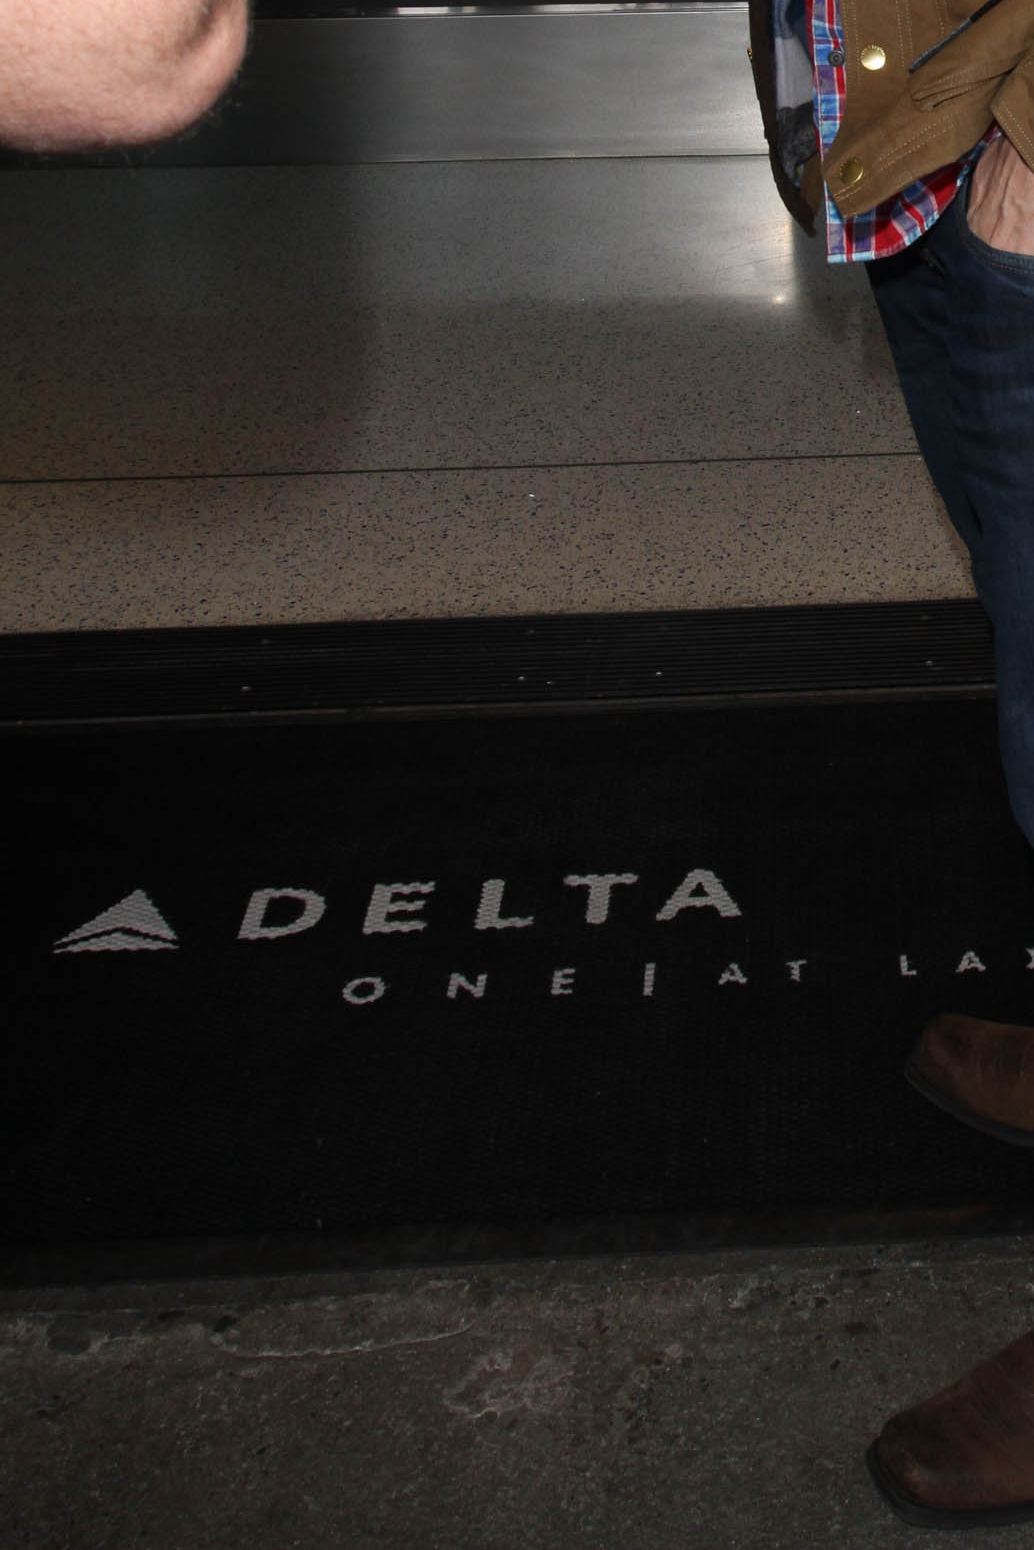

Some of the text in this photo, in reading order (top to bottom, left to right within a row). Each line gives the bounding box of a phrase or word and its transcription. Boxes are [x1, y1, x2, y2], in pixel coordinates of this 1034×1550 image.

[236, 868, 742, 940] DELTA
[342, 967, 576, 1005] ONE
[716, 958, 809, 987] AT
